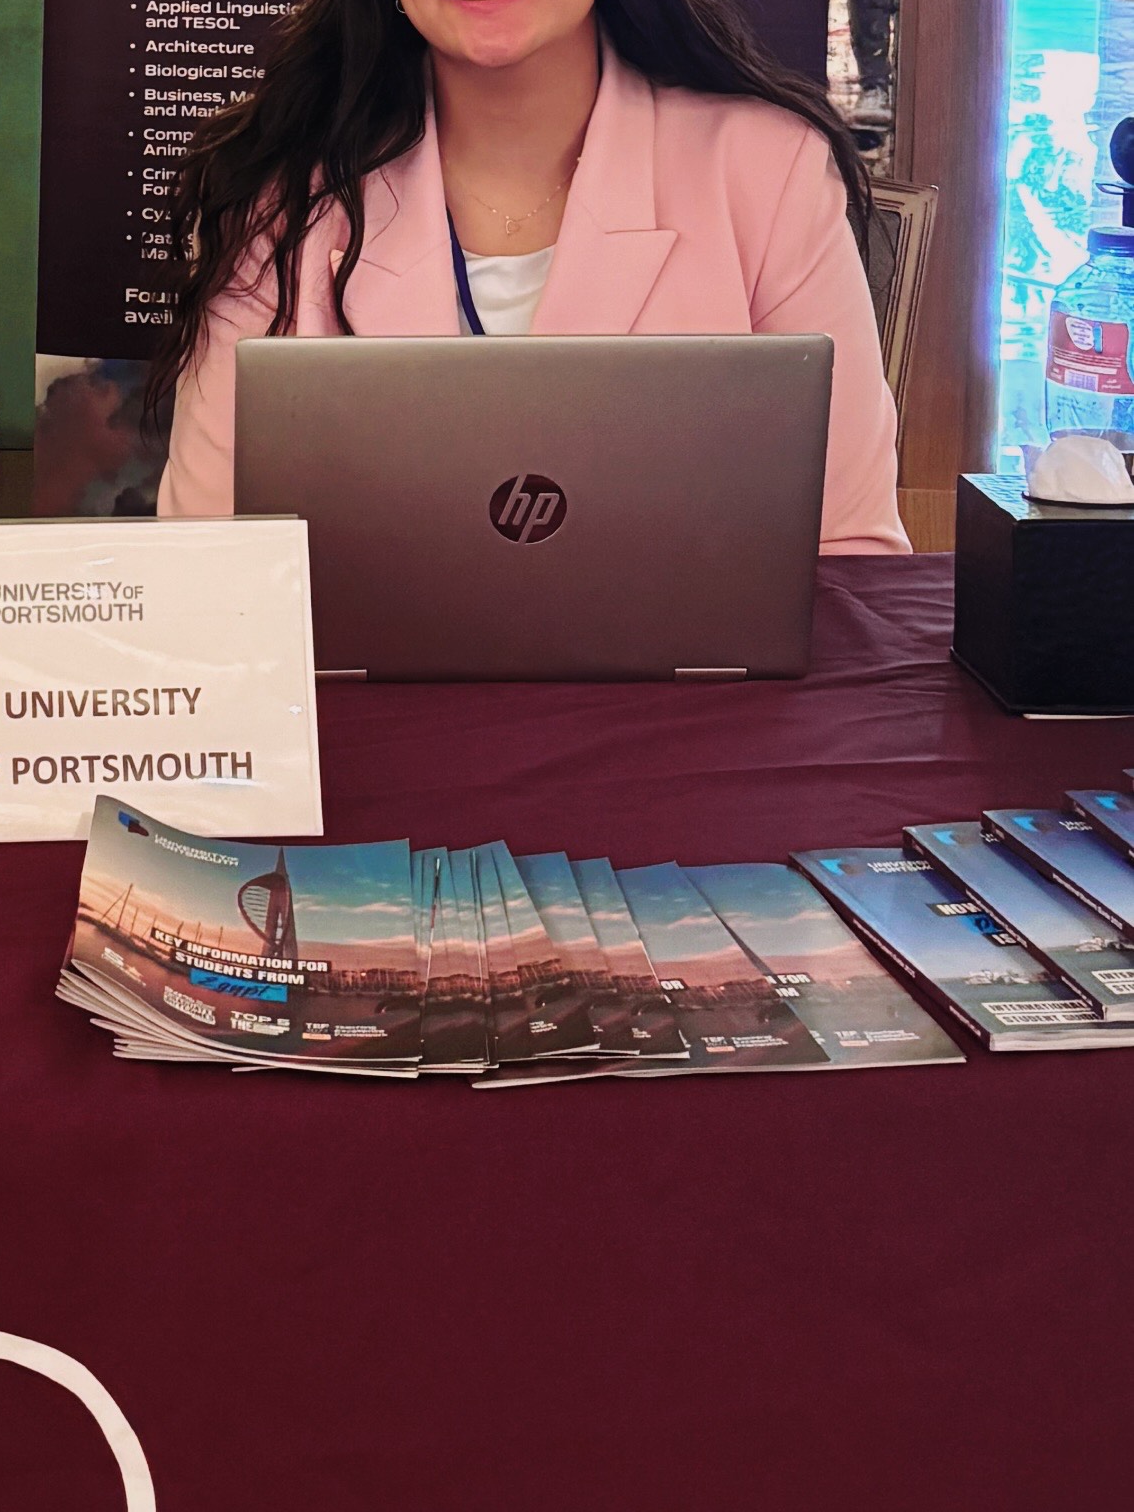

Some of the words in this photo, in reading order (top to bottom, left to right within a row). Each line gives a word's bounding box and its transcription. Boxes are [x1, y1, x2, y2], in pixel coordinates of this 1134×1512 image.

[146, 0, 212, 16] Applied
[145, 17, 178, 29] and
[182, 17, 241, 30] TESOL
[145, 40, 254, 55] Architecture
[144, 64, 228, 80] Biological
[144, 88, 226, 105] Business,
[143, 104, 177, 116] and
[498, 473, 560, 545] hp
[5, 687, 202, 719] UNIVERSITY
[13, 751, 253, 786] PORTSMOUTH
[154, 929, 182, 948] KEY
[187, 944, 293, 970] INFORMATION
[297, 960, 328, 972] FOR
[175, 951, 254, 979] STUDENTS
[257, 970, 305, 985] FROM
[781, 974, 811, 984] FOR
[230, 1010, 272, 1024] TOP
